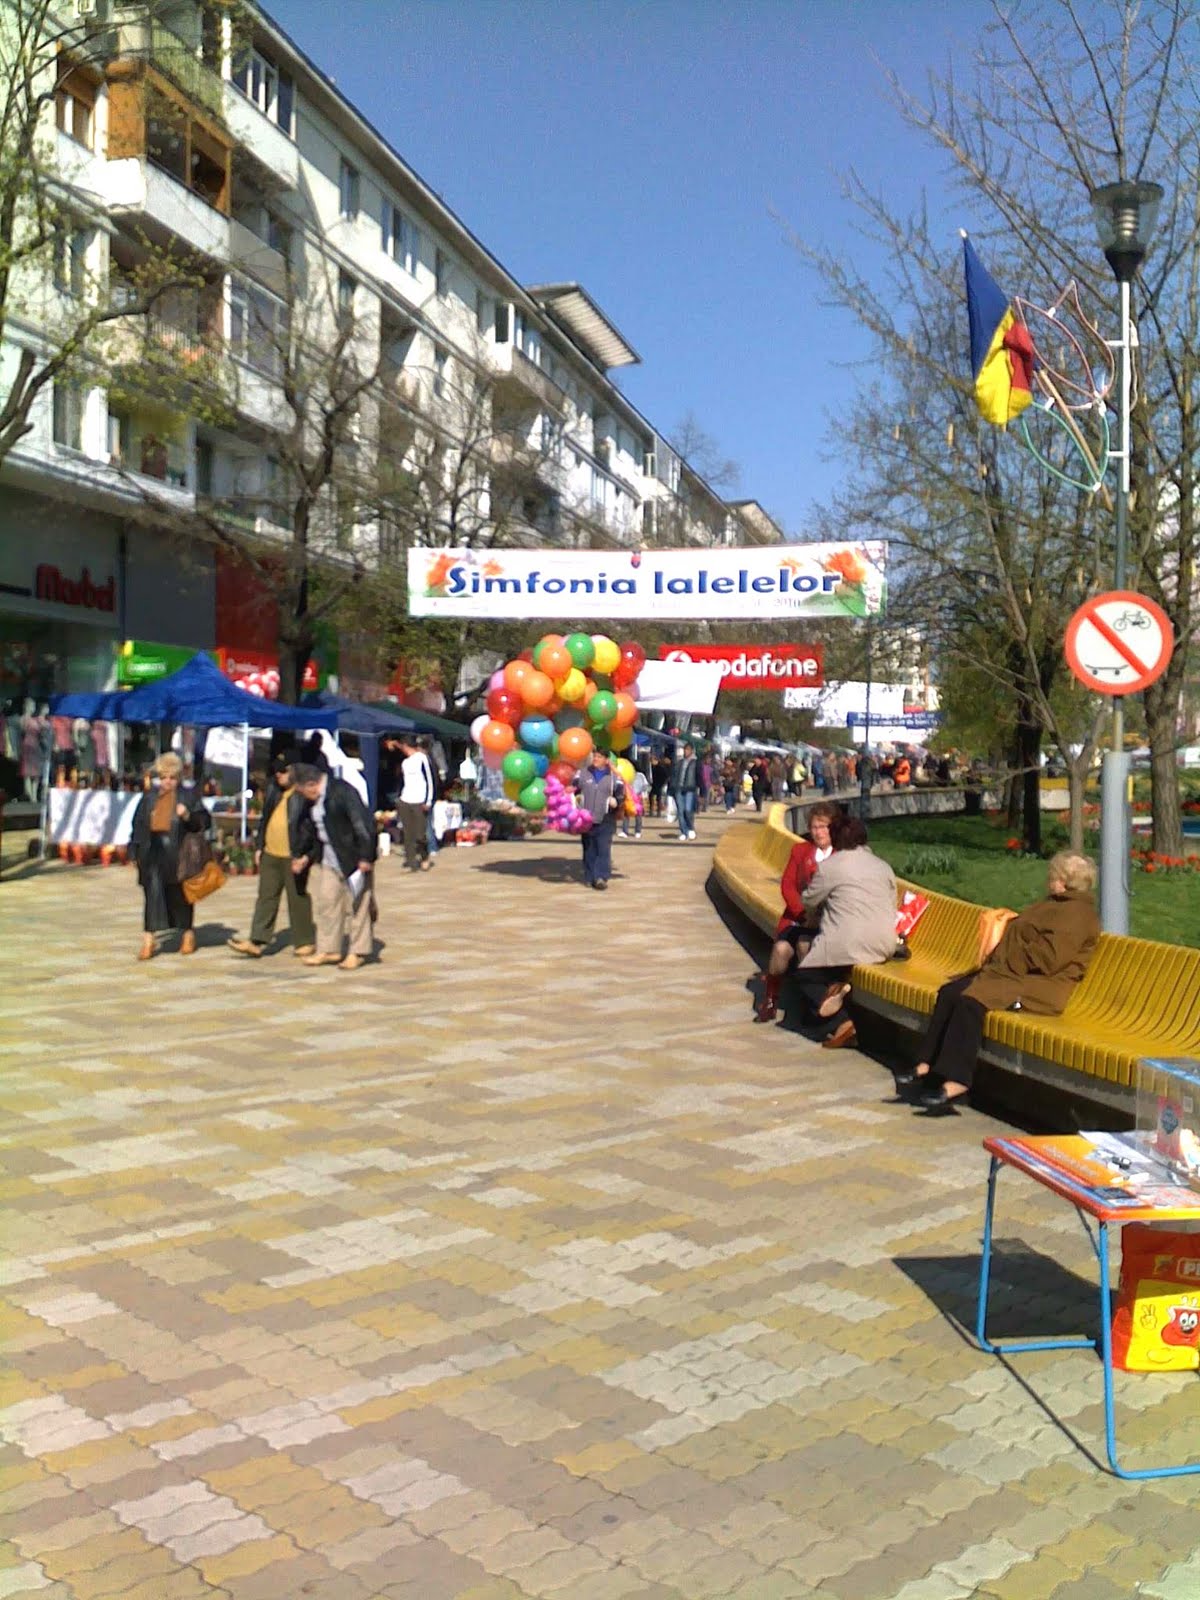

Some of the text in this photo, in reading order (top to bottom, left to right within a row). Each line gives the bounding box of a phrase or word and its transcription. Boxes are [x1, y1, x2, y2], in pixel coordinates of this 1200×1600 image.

[449, 567, 841, 594] Simfonia lalelelor
[700, 652, 818, 677] odafone
